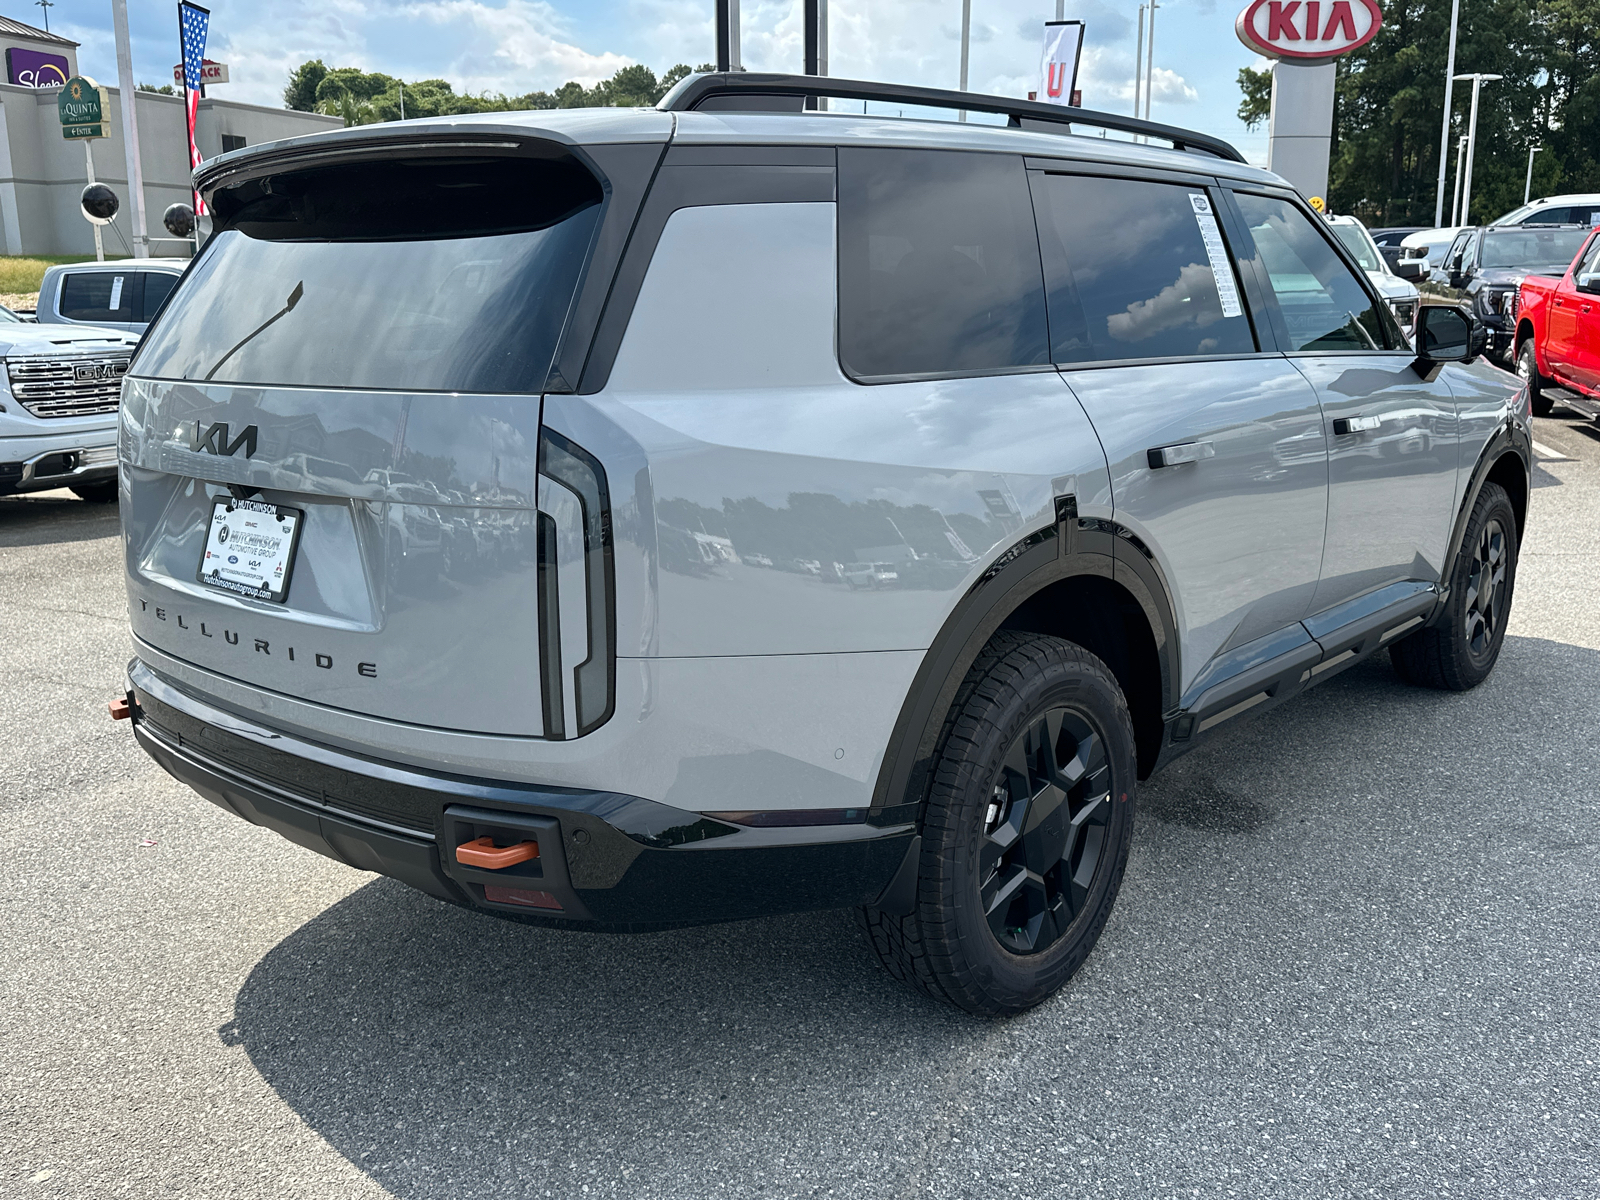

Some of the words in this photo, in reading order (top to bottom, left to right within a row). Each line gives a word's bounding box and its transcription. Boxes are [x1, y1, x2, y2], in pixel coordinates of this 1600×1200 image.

[1268, 1, 1358, 40] KIA
[173, 66, 221, 80] OACK
[65, 102, 98, 117] QUINTA
[76, 127, 92, 136] ENTER
[77, 365, 129, 380] GMC
[238, 500, 277, 515] HUTCHINSON
[230, 530, 282, 551] HUTCHINSON
[229, 543, 258, 556] AUTOMOTIVE
[258, 548, 277, 559] GROUP
[139, 598, 378, 678] TELLURIDE
